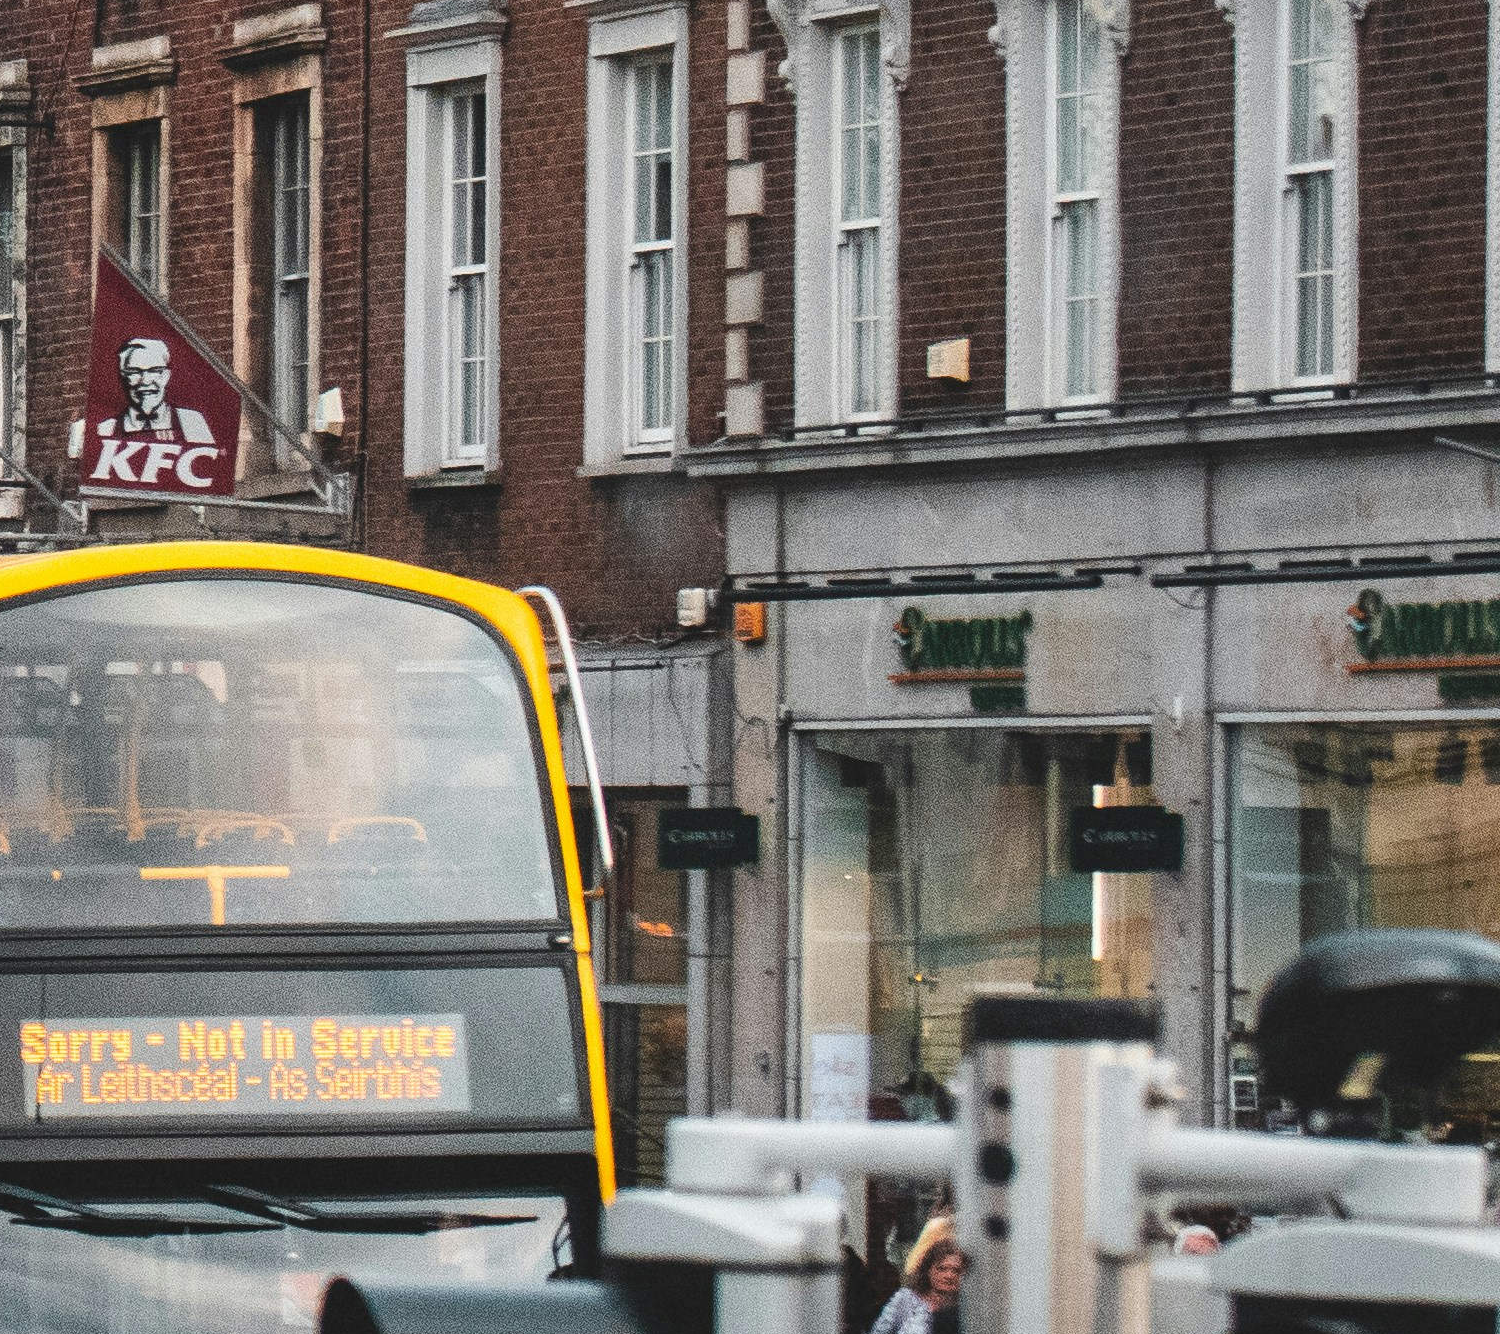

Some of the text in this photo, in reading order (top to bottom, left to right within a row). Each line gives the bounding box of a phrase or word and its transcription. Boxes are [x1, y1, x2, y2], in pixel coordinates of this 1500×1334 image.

[90, 438, 219, 489] KFC
[20, 1021, 132, 1063] Sorry
[179, 1020, 245, 1060] Not
[262, 1020, 295, 1059] in
[311, 1019, 455, 1059] Service
